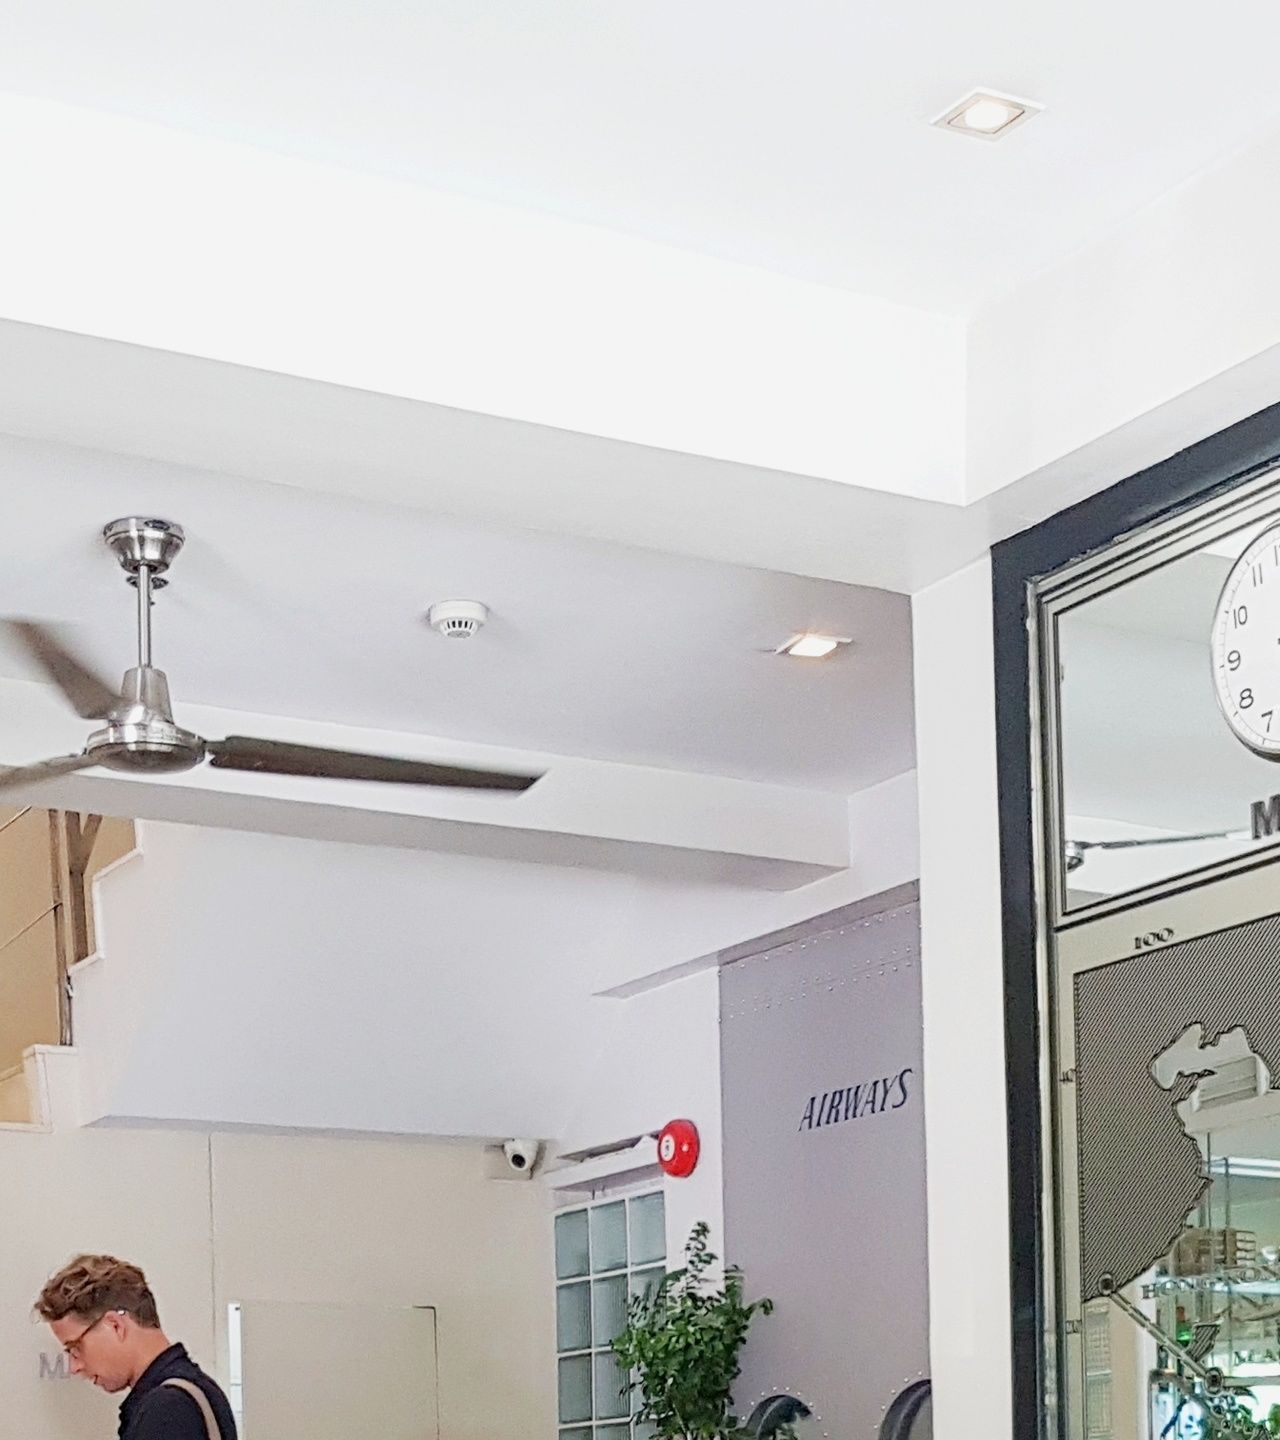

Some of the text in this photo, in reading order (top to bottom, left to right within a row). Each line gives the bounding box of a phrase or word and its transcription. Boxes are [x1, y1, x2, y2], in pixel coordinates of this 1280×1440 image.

[1251, 565, 1264, 587] 11
[1233, 606, 1248, 628] 10
[1227, 650, 1241, 671] 9
[1239, 688, 1254, 709] 8
[1261, 711, 1274, 732] 7
[1134, 927, 1174, 949] 100
[798, 1067, 913, 1132] AIRWAYS
